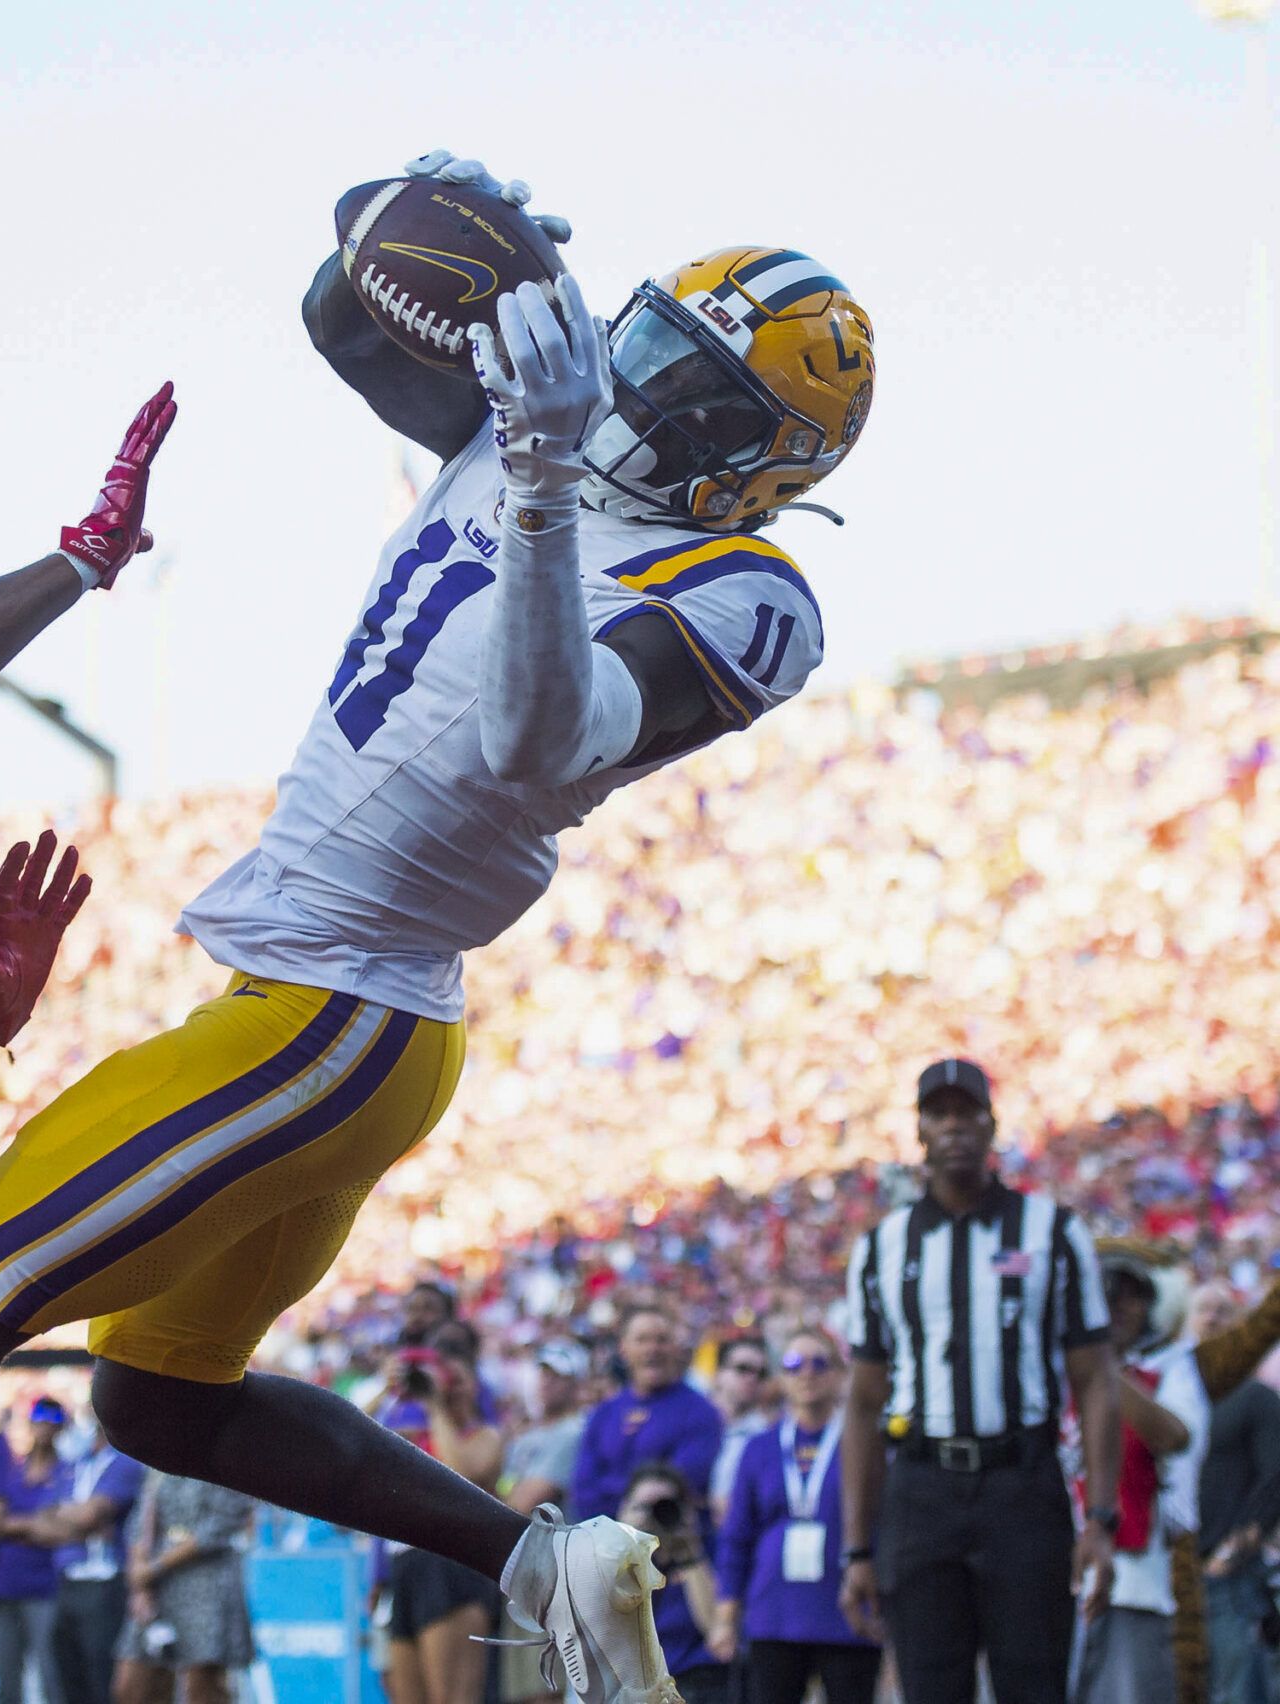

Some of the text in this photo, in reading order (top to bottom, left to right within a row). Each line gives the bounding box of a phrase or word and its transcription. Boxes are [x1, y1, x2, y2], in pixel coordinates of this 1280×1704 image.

[430, 193, 517, 255] VAPOR ELITE
[697, 296, 742, 336] LSU
[68, 539, 111, 567] CUTTERS
[463, 517, 499, 559] LSU
[328, 517, 496, 752] 11
[738, 602, 796, 687] 11
